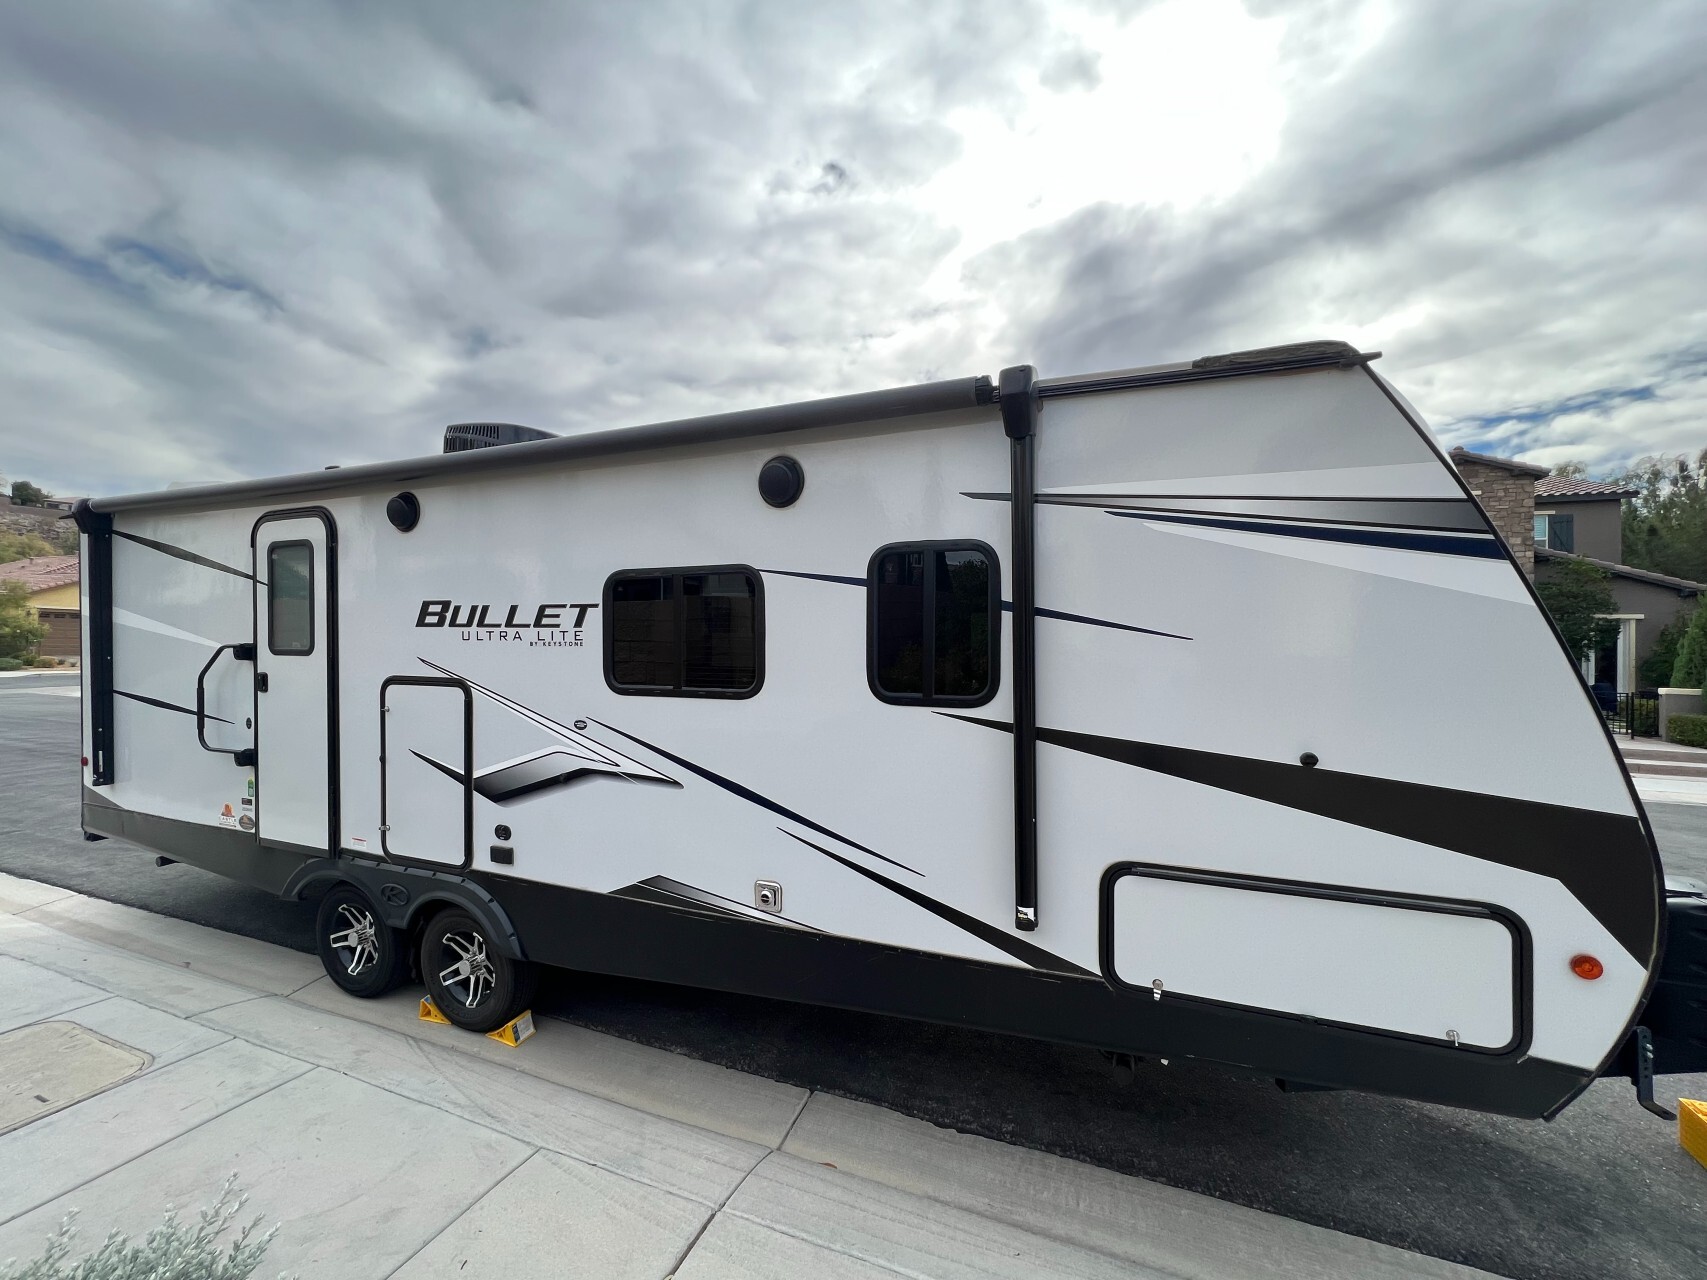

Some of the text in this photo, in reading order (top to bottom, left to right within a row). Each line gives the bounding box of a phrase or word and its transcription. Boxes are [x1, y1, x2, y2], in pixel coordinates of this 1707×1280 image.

[415, 600, 599, 628] BULLET
[461, 631, 583, 641] ULTRA LITE
